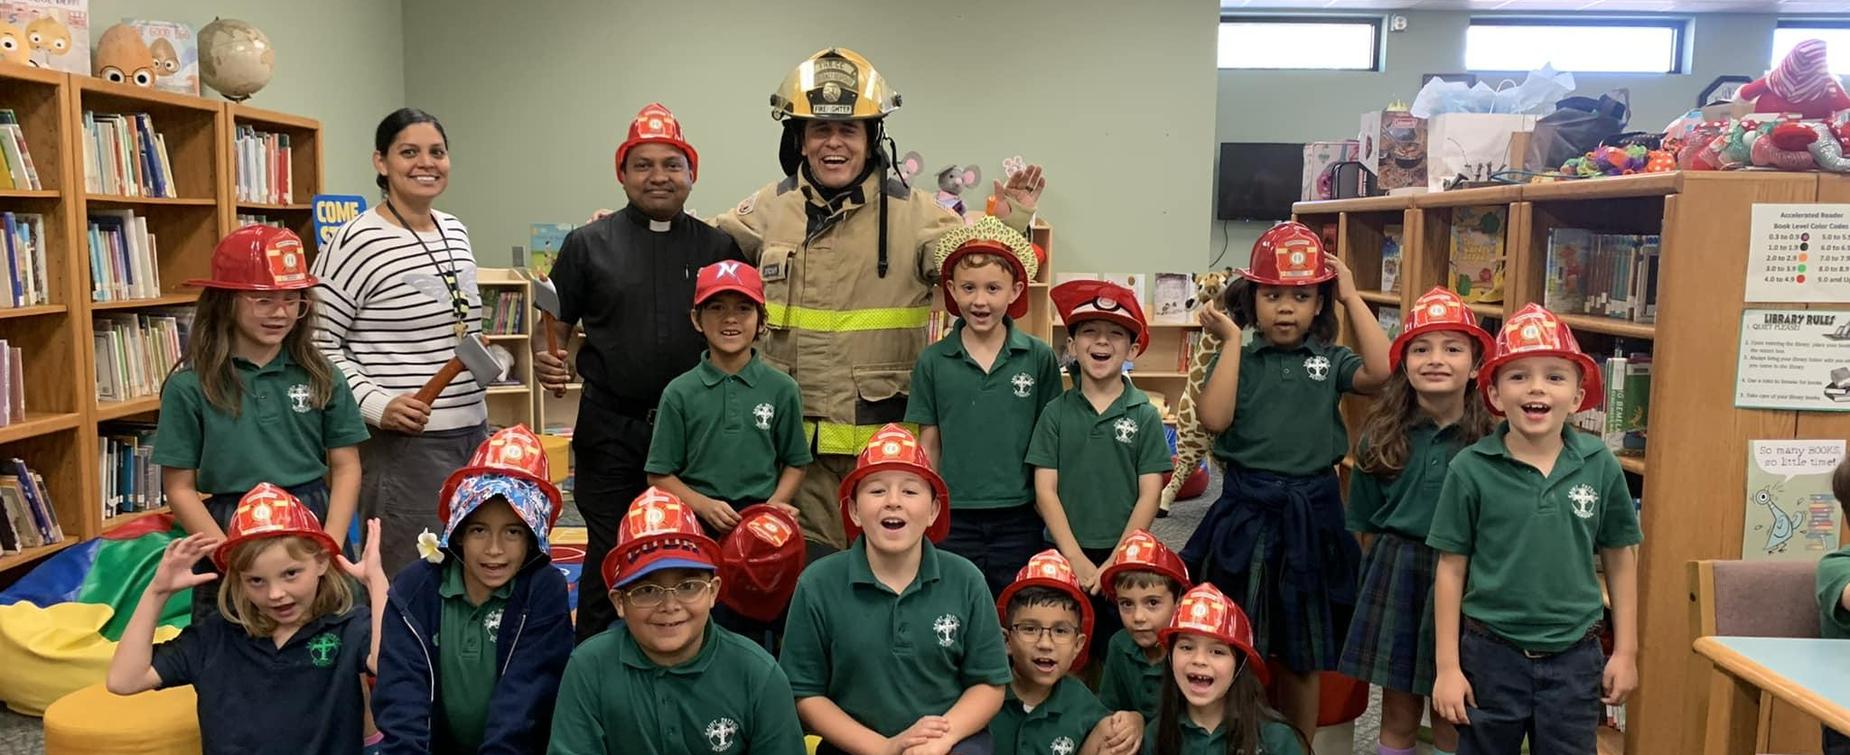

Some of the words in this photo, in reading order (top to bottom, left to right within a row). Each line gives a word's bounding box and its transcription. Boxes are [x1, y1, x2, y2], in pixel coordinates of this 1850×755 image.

[316, 201, 358, 223] COME
[717, 262, 740, 279] N
[1764, 314, 1804, 324] LIBRARY
[1806, 315, 1835, 325] RULES
[1760, 446, 1772, 454] So
[1776, 447, 1805, 457] many
[1781, 457, 1807, 466] little
